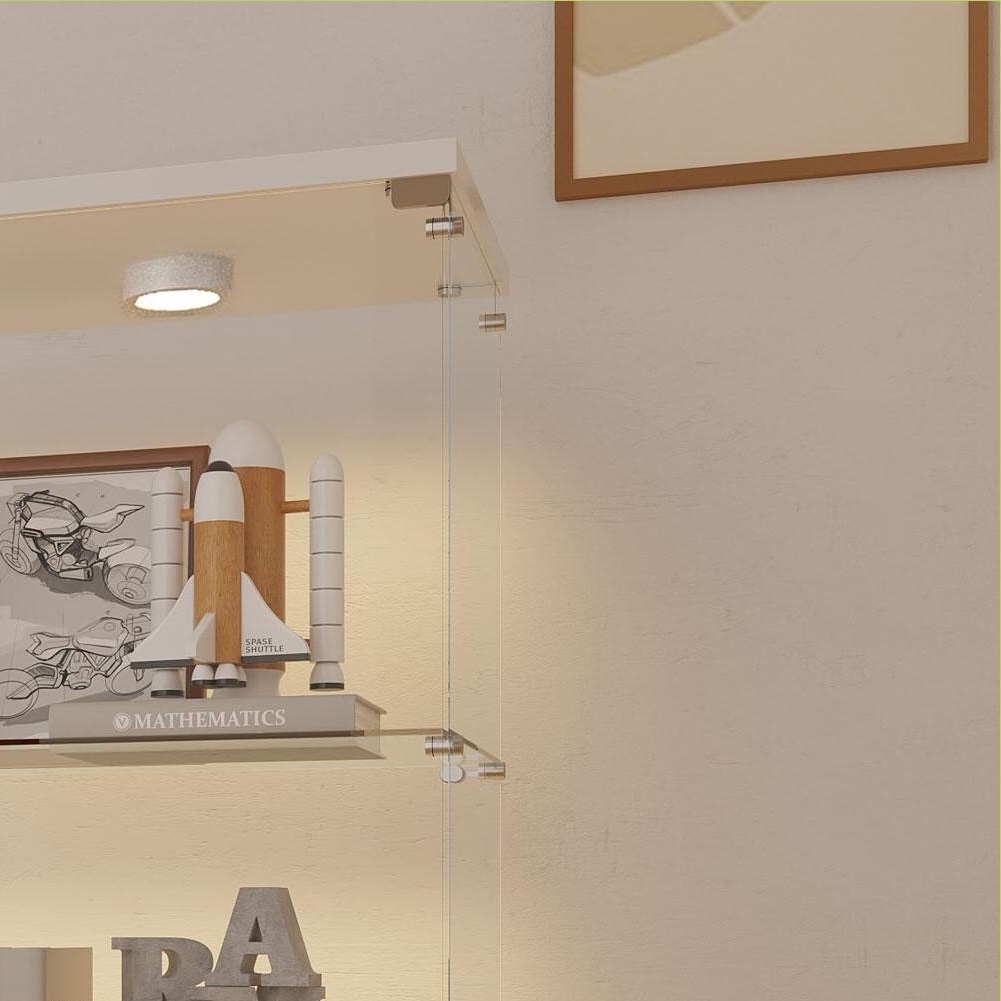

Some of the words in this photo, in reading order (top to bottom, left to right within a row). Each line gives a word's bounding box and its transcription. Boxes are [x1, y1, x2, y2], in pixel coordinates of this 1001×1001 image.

[245, 637, 274, 646] SPASE
[245, 644, 285, 654] SHUTTLE
[134, 709, 287, 730] MATHEMATICS
